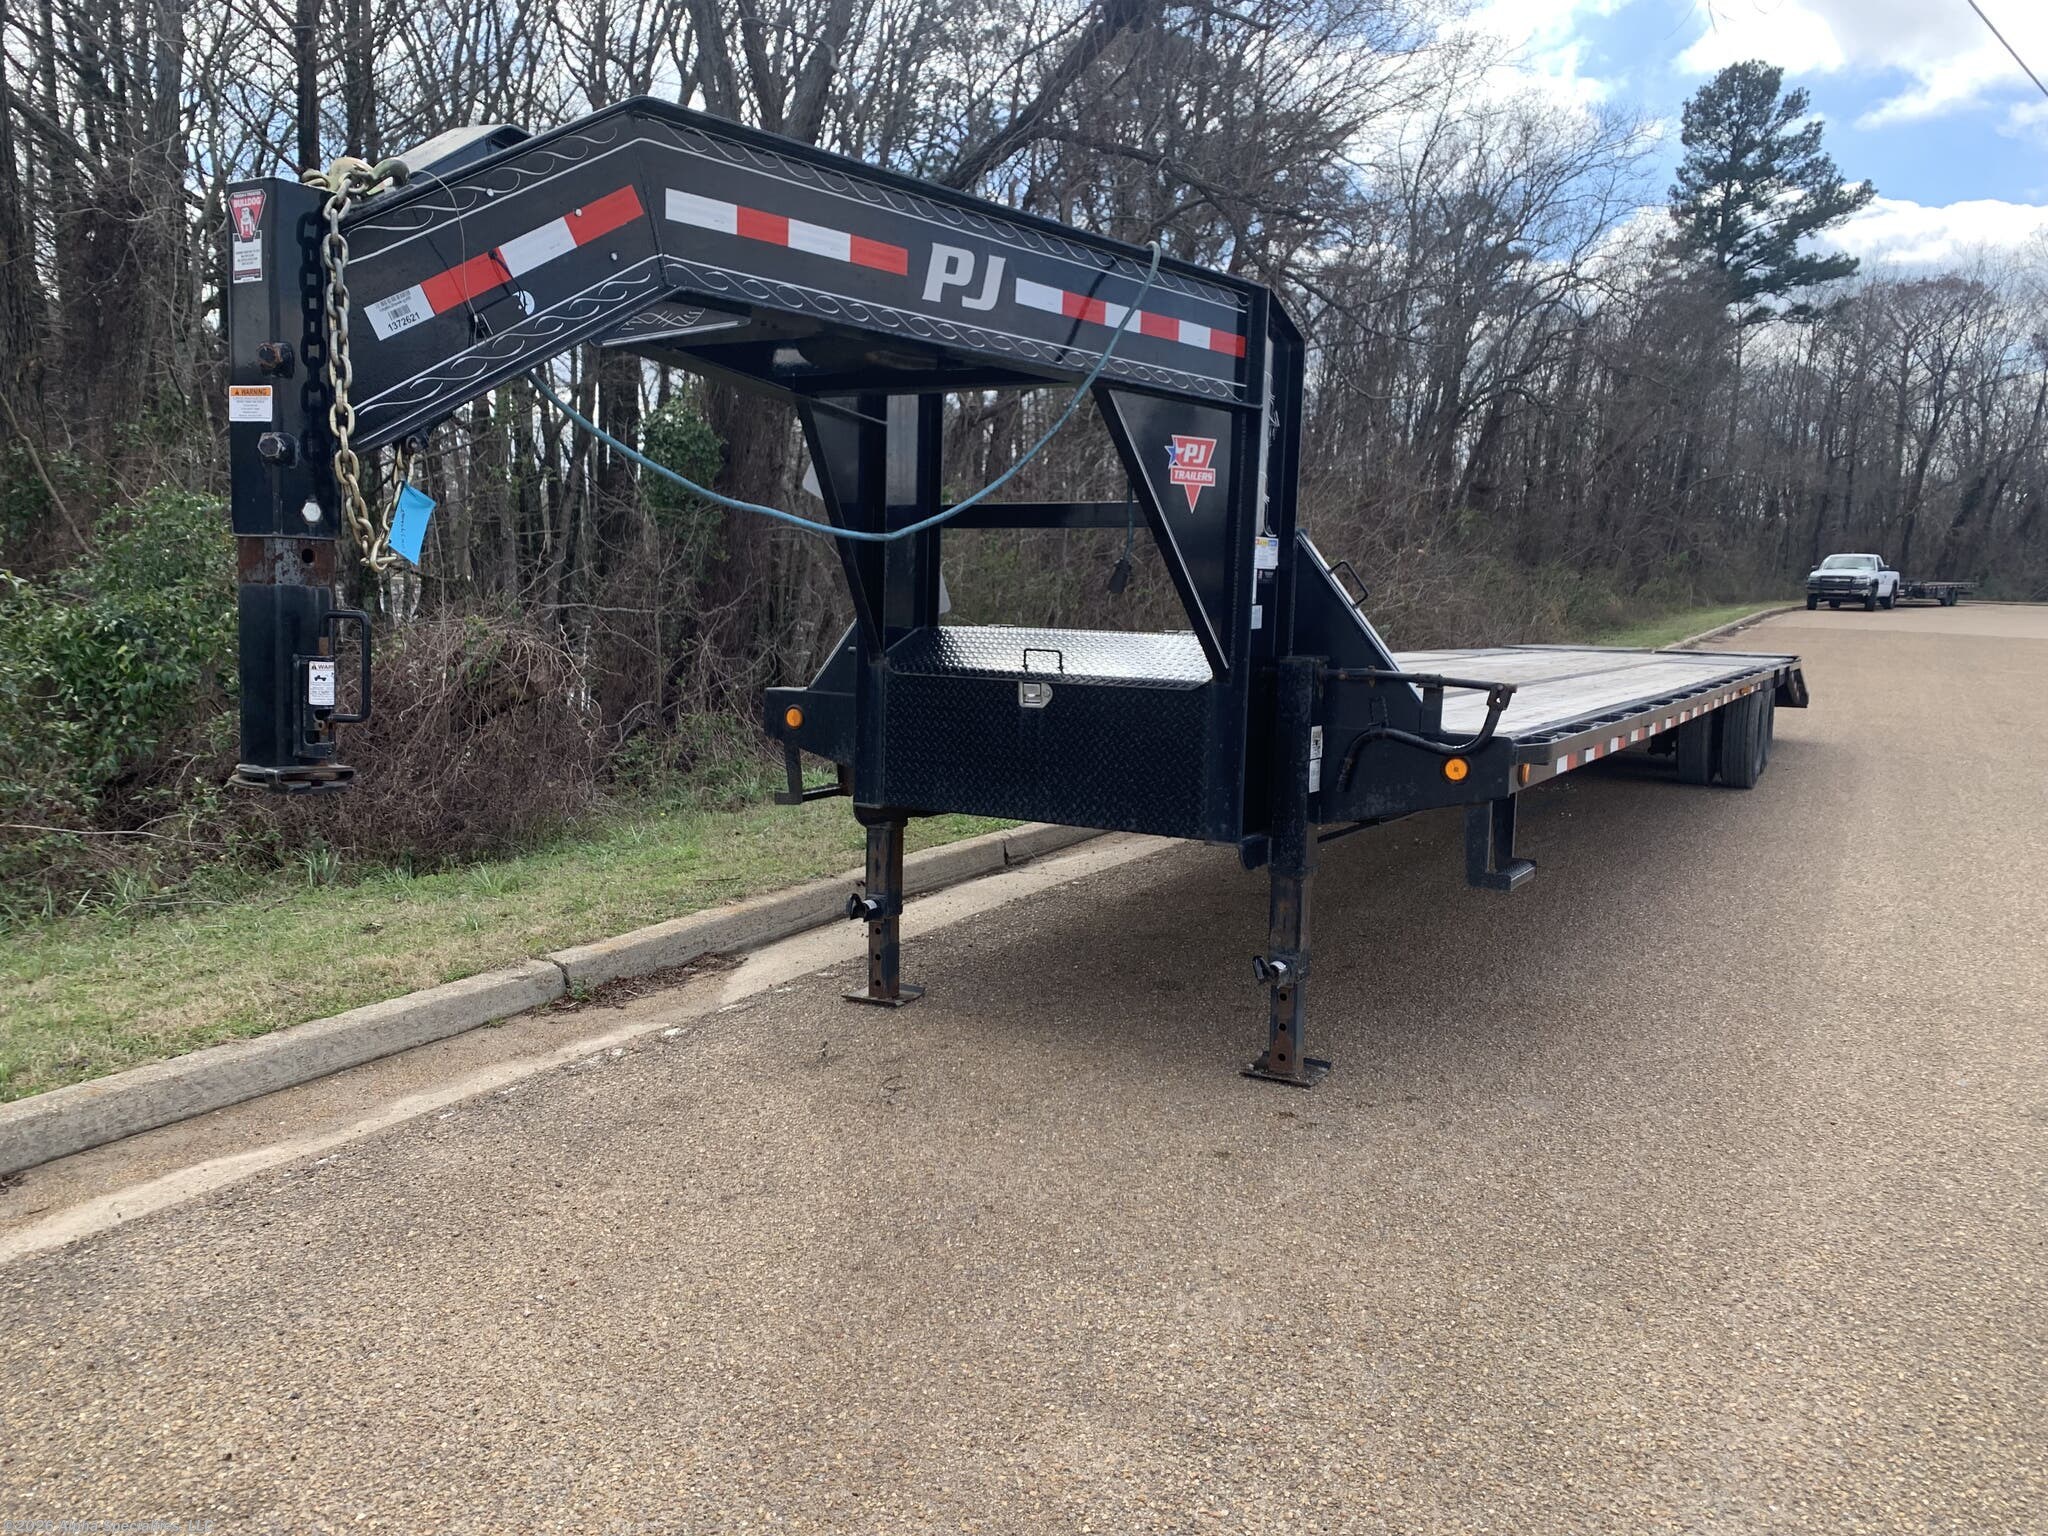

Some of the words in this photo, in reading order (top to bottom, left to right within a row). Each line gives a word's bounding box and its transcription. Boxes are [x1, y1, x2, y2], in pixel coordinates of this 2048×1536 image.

[233, 196, 262, 208] BULLDOG
[922, 242, 1006, 311] PJ
[387, 311, 421, 332] 1372621
[241, 388, 267, 396] WARNING
[1184, 443, 1207, 463] PJ
[1174, 469, 1213, 482] TRAILERS
